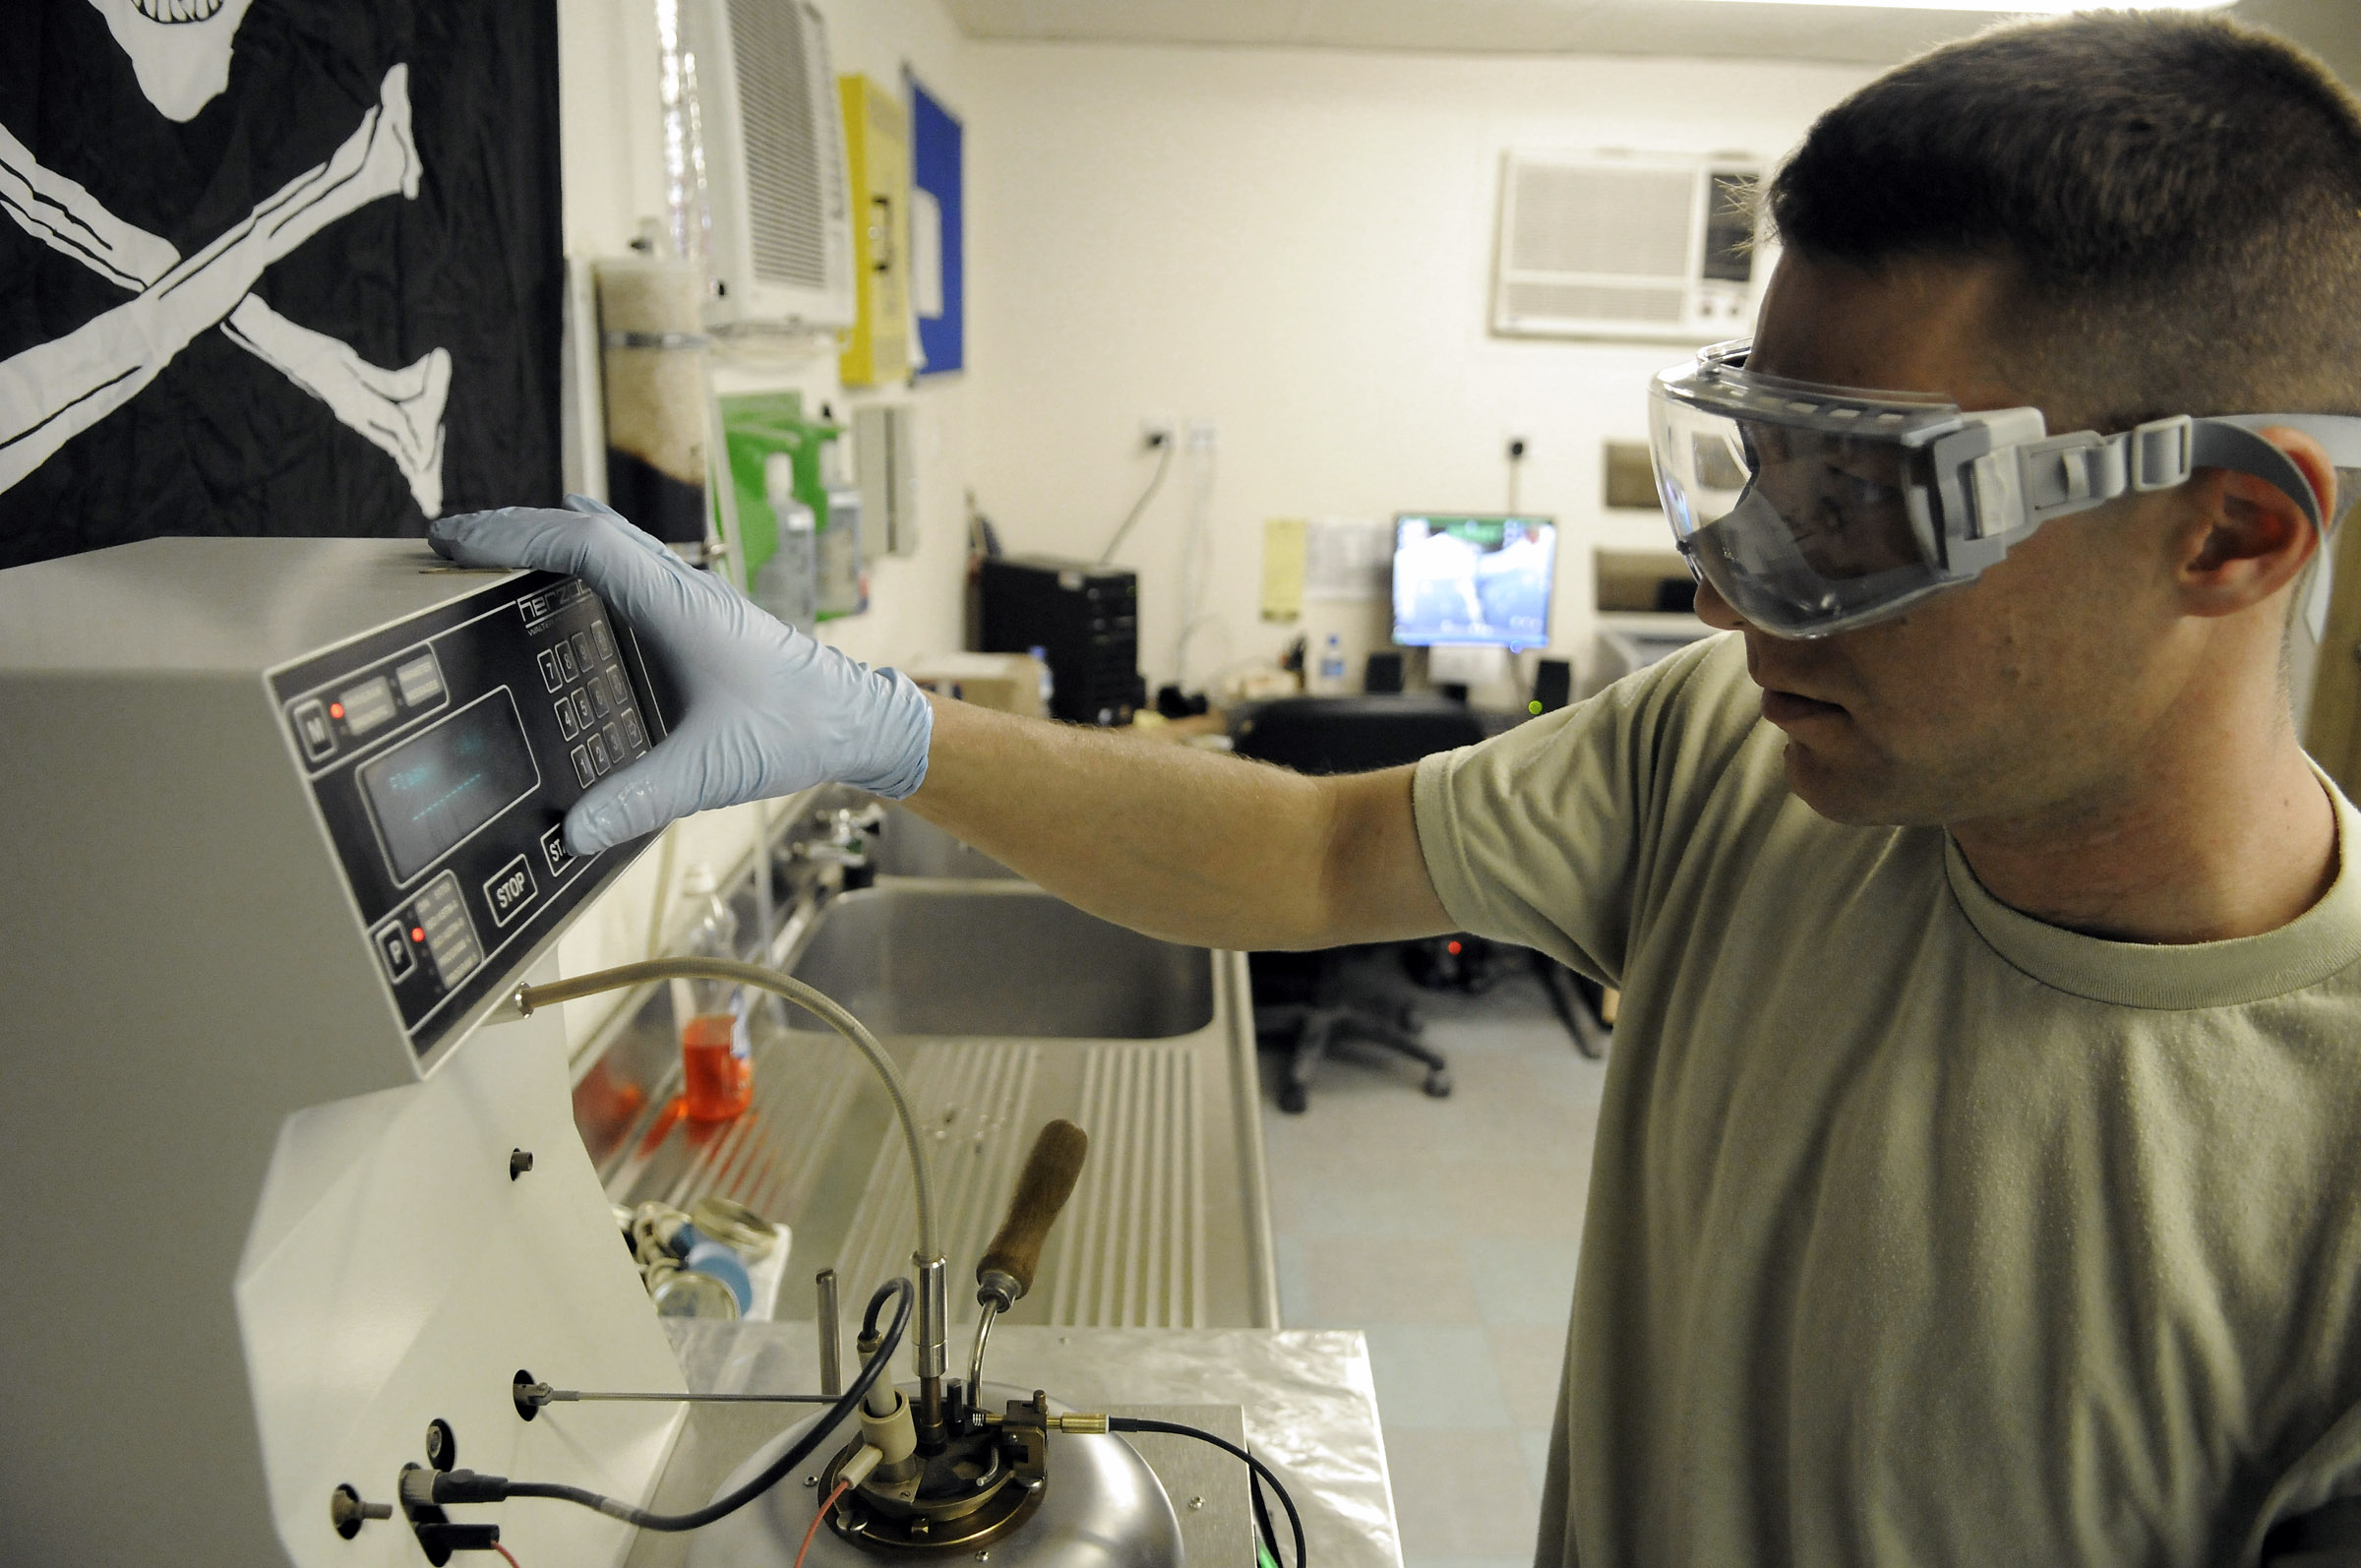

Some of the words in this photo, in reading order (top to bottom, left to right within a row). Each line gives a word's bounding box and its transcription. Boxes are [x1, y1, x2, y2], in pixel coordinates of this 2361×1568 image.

[546, 662, 555, 680] 7
[564, 653, 572, 670] 8
[564, 710, 572, 727] 4
[579, 699, 588, 716] 5
[306, 716, 326, 746] M
[580, 756, 588, 775] 1
[596, 746, 604, 762] 2
[496, 872, 525, 909] STOP
[389, 939, 403, 964] P
